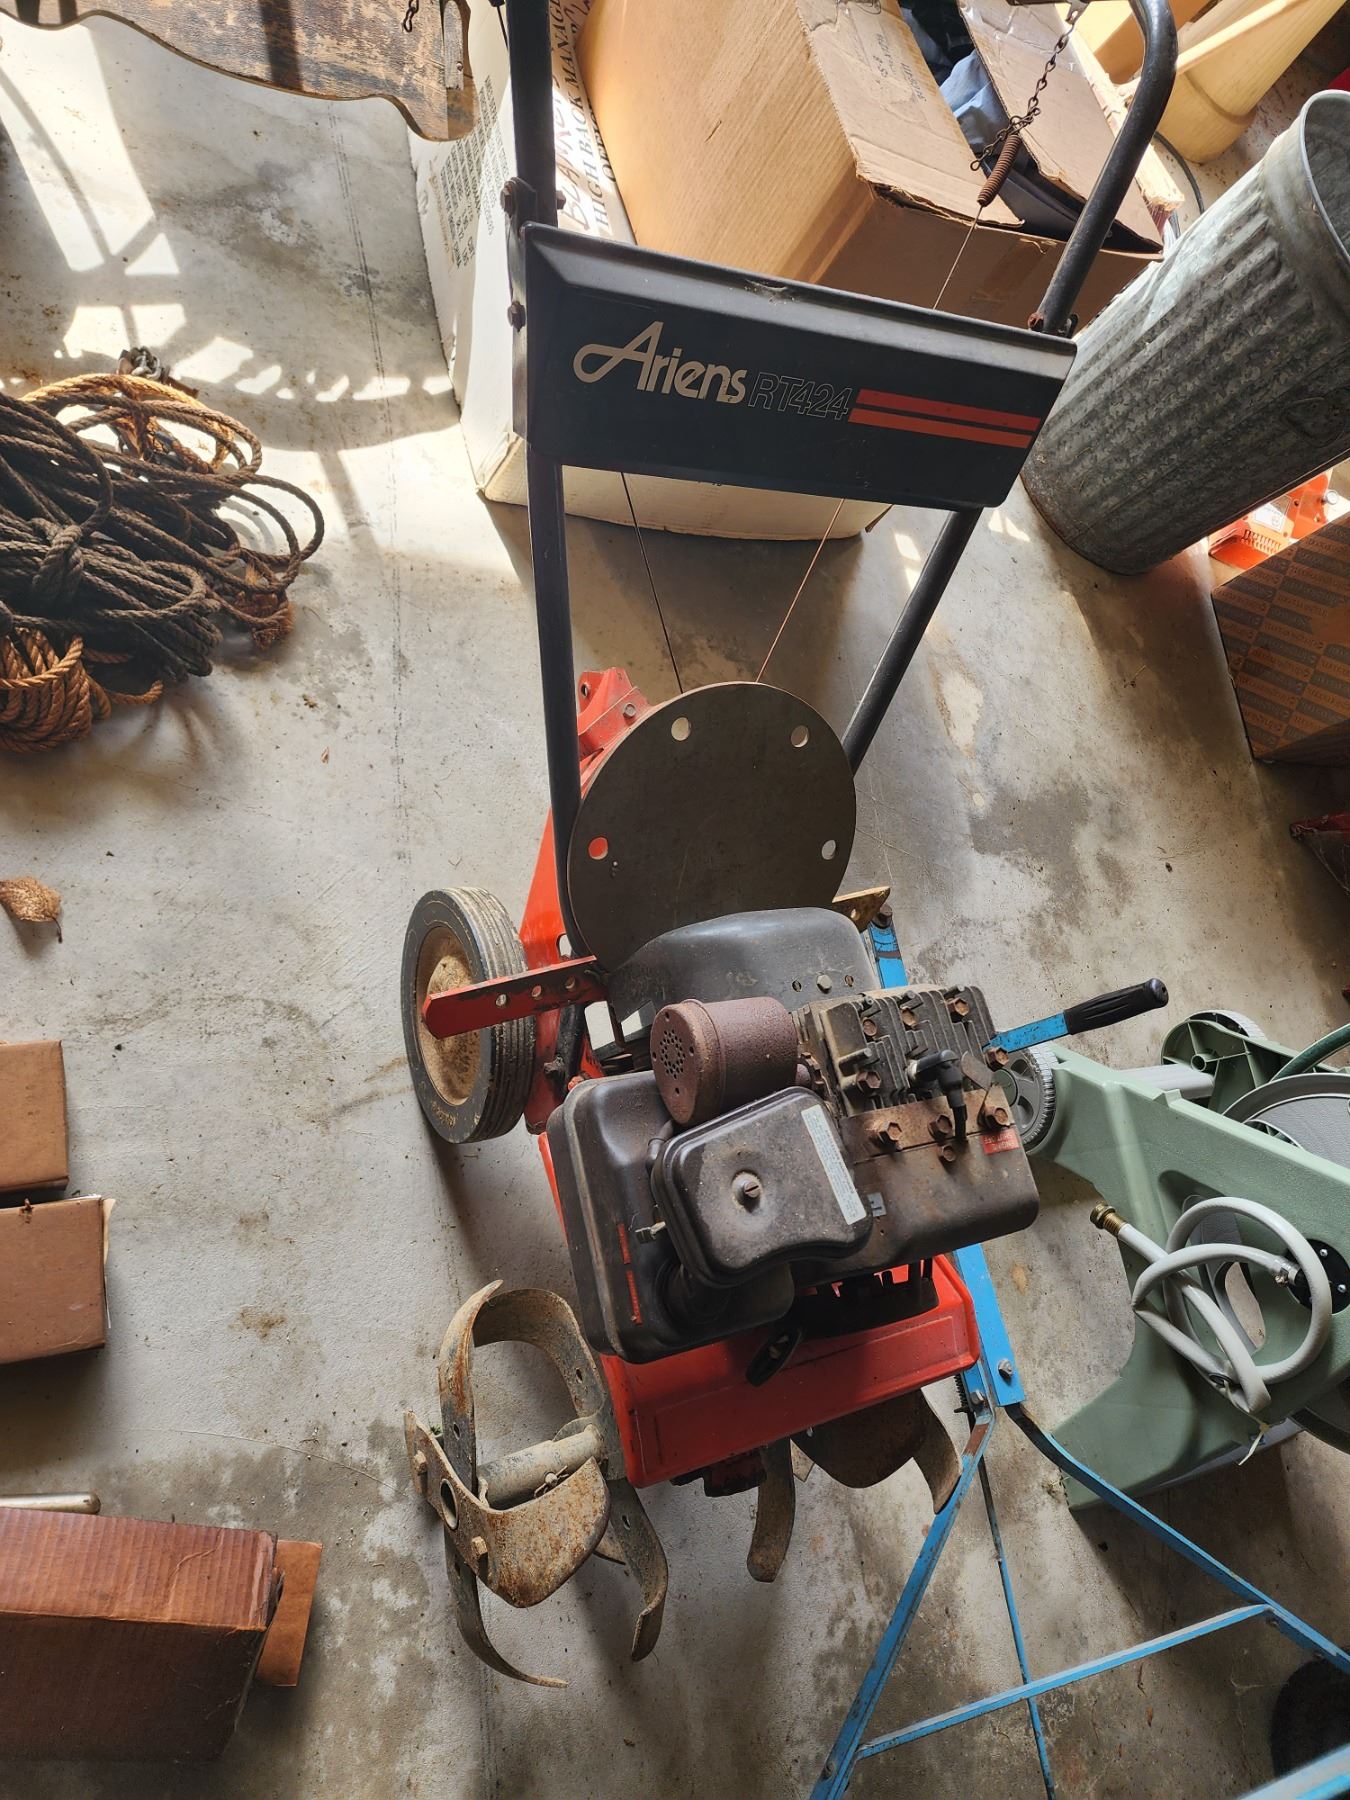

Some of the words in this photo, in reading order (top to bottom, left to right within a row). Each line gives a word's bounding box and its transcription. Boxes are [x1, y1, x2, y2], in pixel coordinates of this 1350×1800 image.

[568, 91, 594, 157] BACK
[582, 160, 609, 227] HIGH
[573, 321, 747, 404] Ariens
[748, 372, 853, 421] RT424
